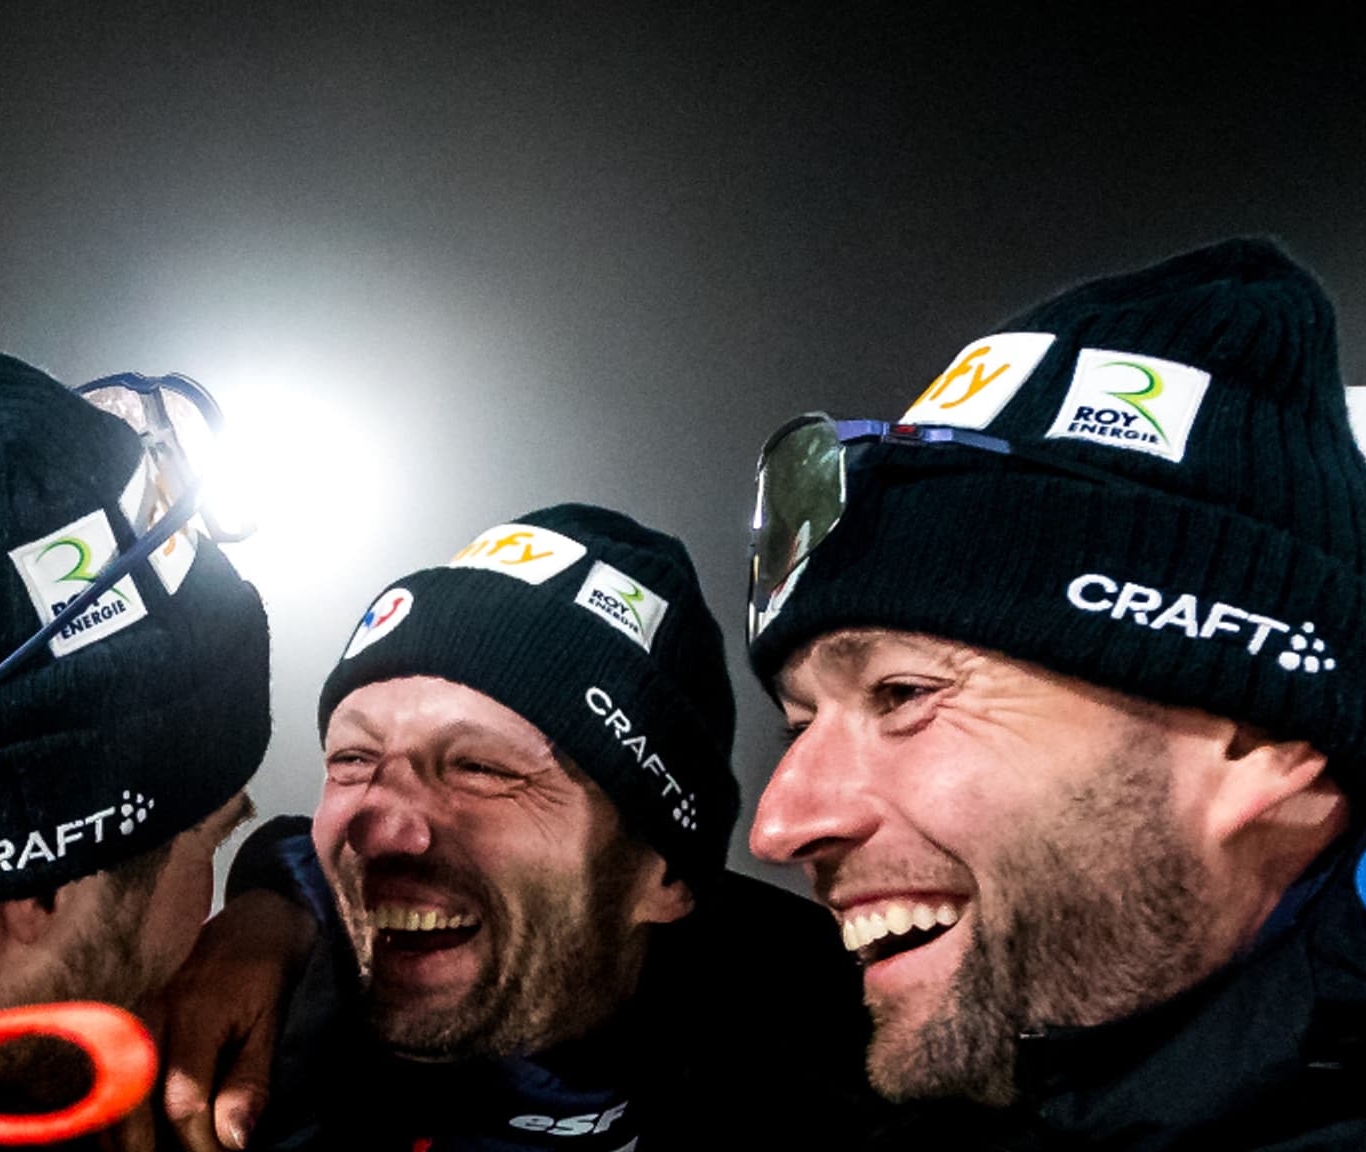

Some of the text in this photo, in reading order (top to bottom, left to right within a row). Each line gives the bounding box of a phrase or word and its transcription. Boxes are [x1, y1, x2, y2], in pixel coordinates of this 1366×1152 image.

[1067, 421, 1160, 445] ENERGIE
[1073, 405, 1139, 428] ROY
[591, 588, 630, 613] ROY
[1066, 573, 1290, 656] CRAFT
[61, 600, 127, 640] ENERGIE
[585, 686, 681, 798] CRAFT
[509, 1101, 628, 1136] esf
